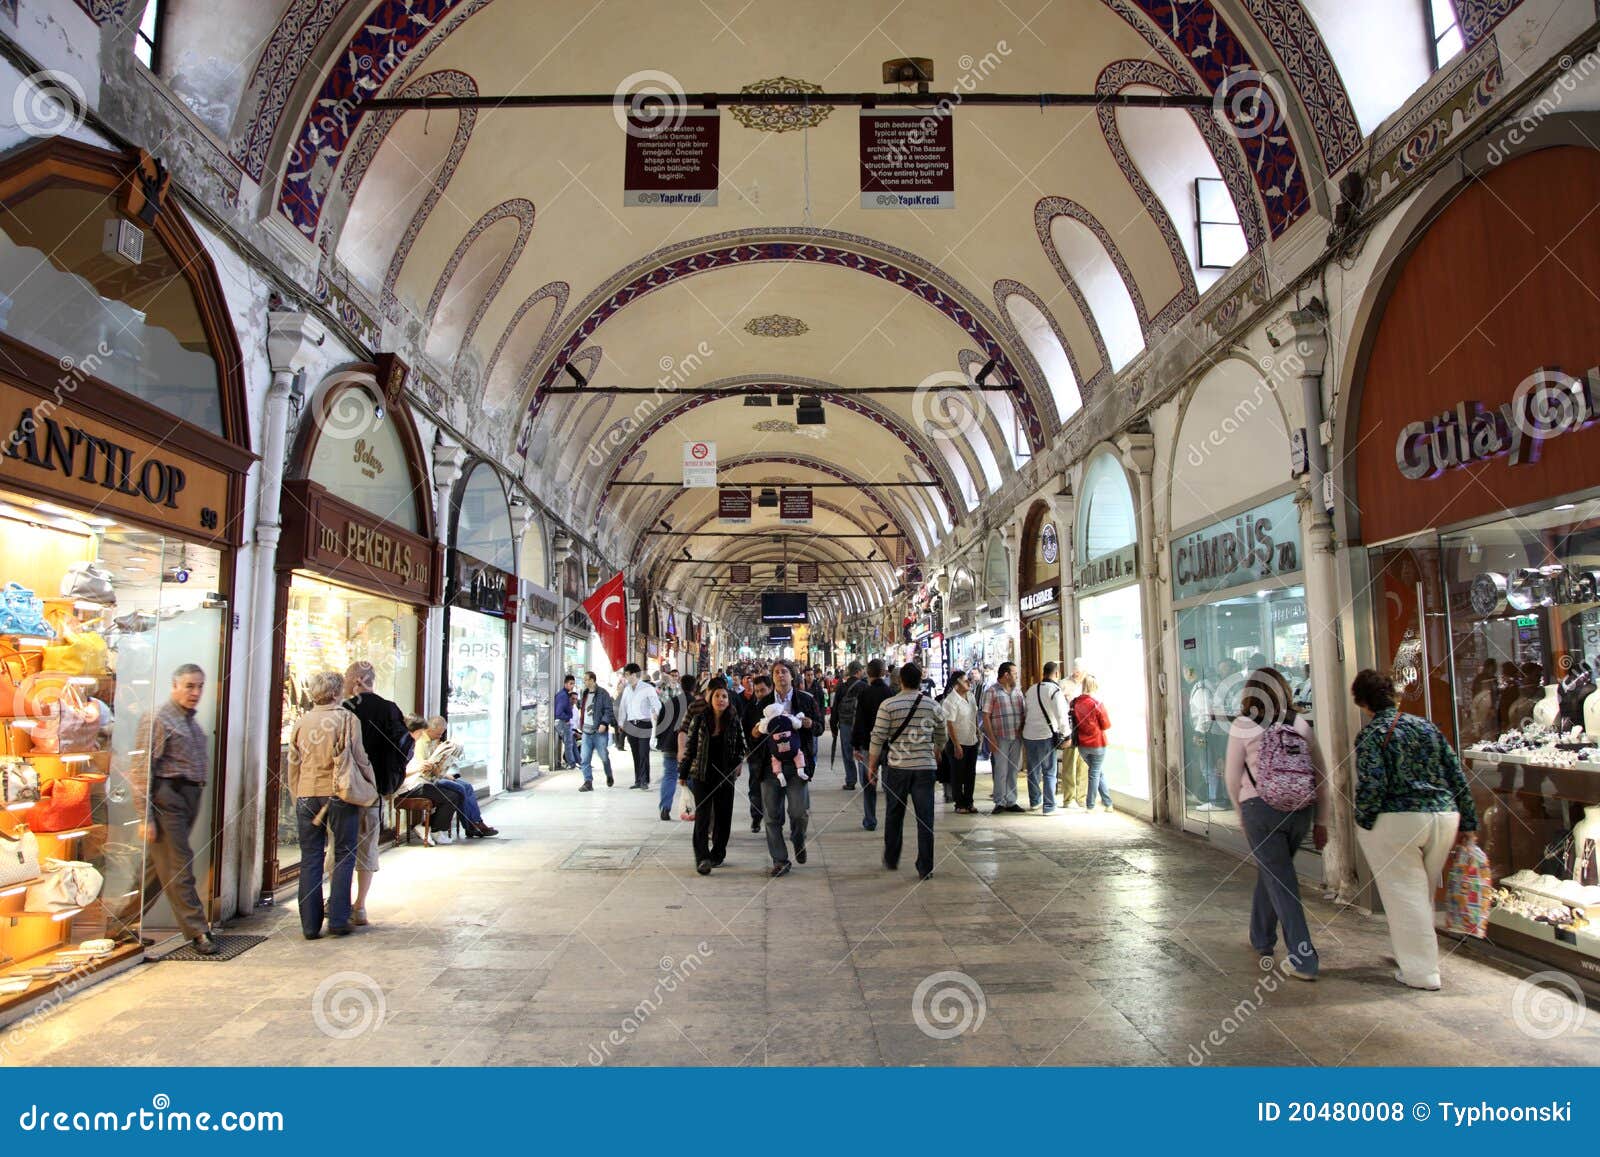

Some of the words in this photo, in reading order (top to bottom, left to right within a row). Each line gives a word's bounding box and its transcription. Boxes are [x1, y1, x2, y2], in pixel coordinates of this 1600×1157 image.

[677, 142, 692, 150] tipik
[894, 170, 920, 178] entirely
[916, 162, 950, 170] beginning
[3, 408, 186, 509] ANTILOP
[320, 527, 342, 555] 101
[348, 520, 391, 571] PEKER
[416, 563, 429, 585] 101
[1177, 515, 1275, 586] CÜMBÜŞ
